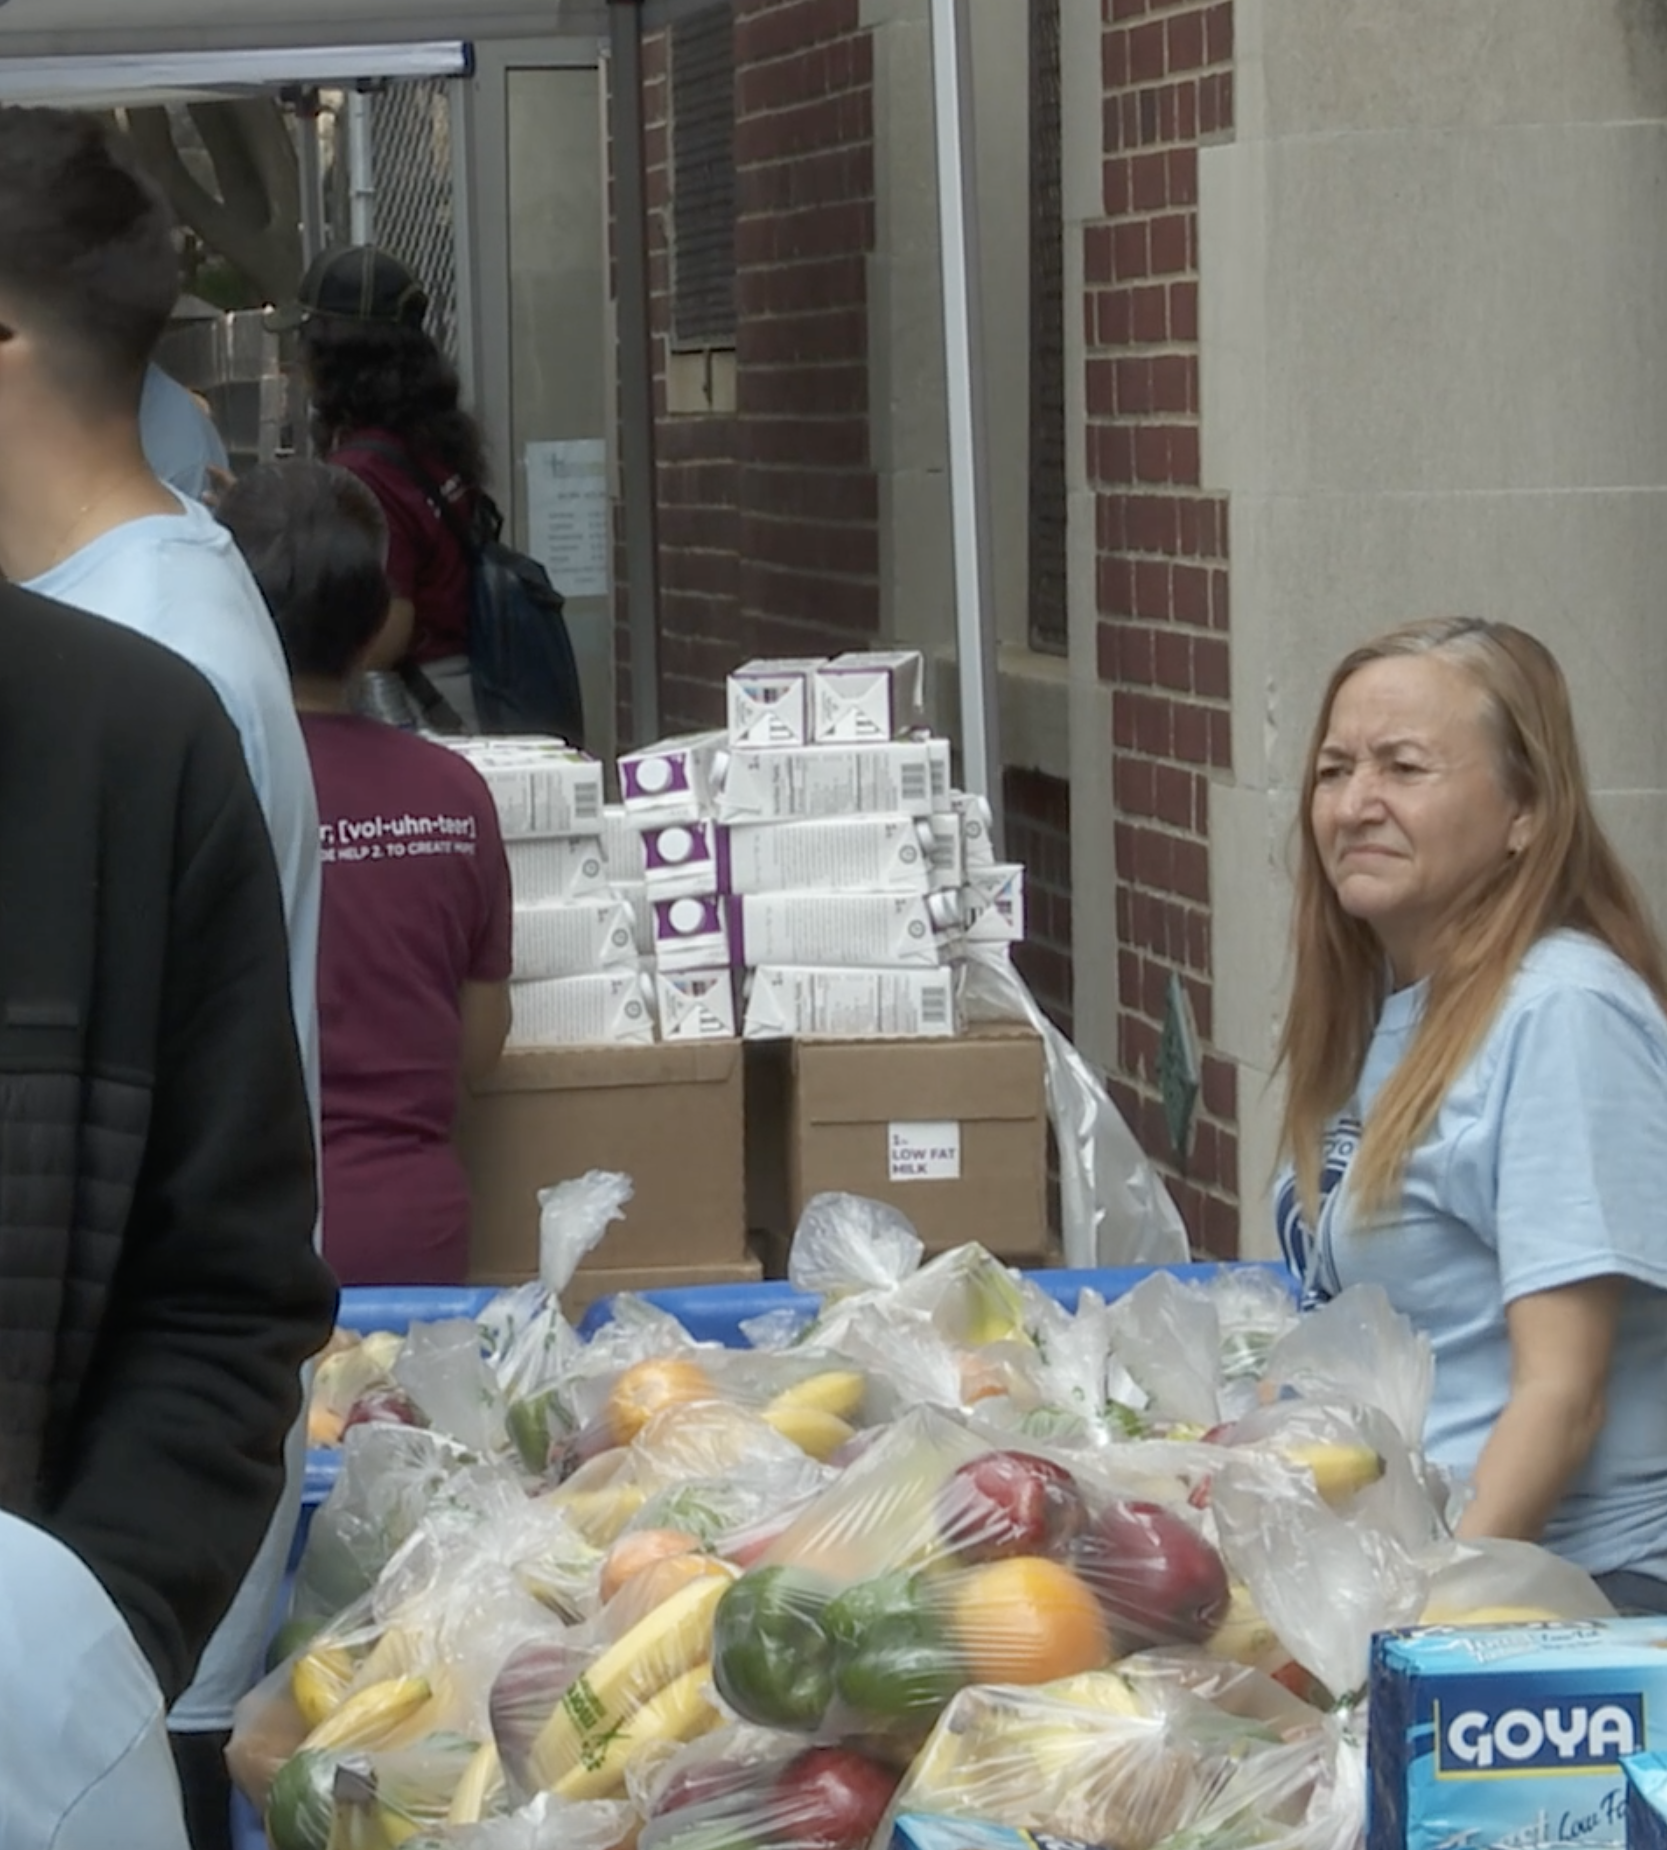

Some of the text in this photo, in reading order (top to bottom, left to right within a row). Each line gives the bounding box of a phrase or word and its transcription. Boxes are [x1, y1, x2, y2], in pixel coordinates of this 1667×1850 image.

[385, 842, 406, 857] TO
[892, 1148, 955, 1160] LOW FAT
[893, 1163, 928, 1174] MILK
[1448, 1705, 1633, 1767] GOYA
[1600, 1788, 1628, 1823] Fa
